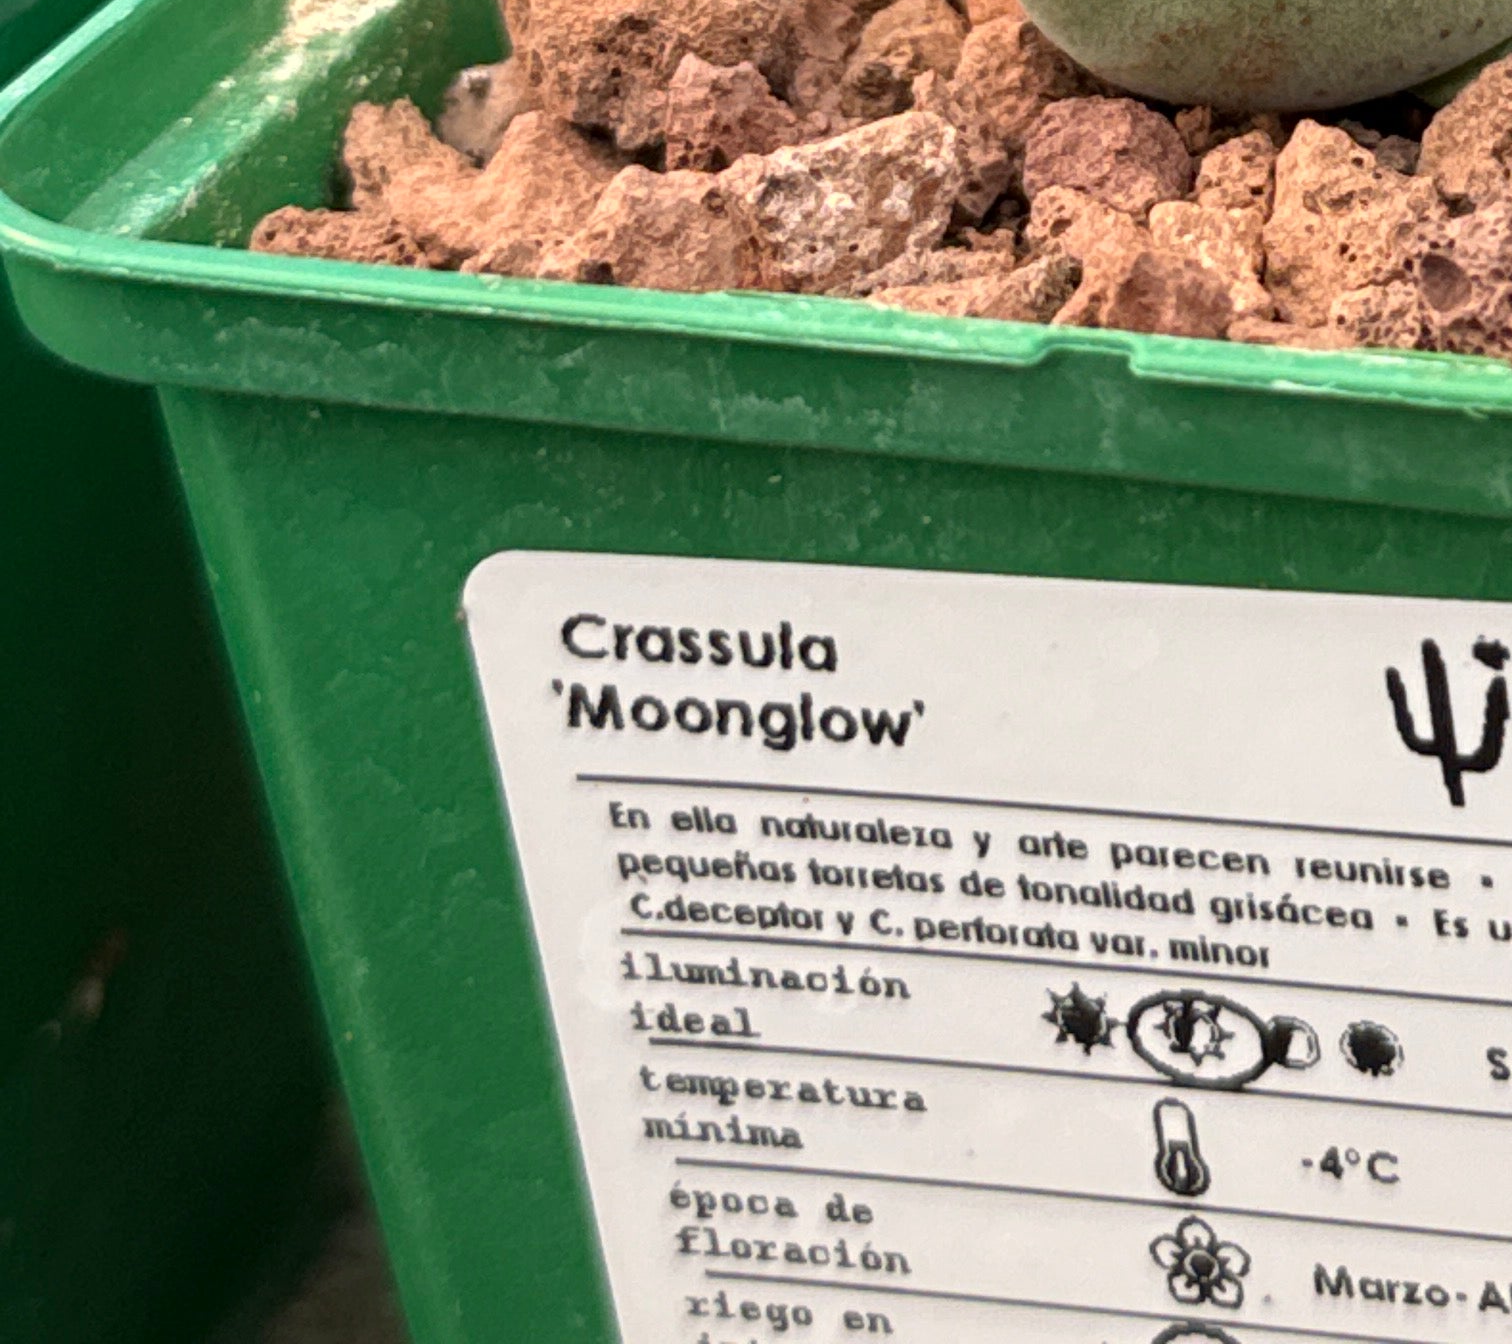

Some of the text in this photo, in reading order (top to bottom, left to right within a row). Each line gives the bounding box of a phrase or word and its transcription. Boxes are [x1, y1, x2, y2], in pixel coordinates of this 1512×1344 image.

[560, 613, 838, 674] Crassula
[552, 679, 925, 753] 'Moonglow'
[609, 801, 651, 830] En
[671, 806, 738, 836] ella
[760, 813, 953, 850] naturaleza
[973, 831, 991, 859] y
[1018, 831, 1088, 860] arte
[1110, 840, 1271, 876] parecen
[1295, 857, 1450, 890] reunirse
[617, 850, 797, 884] pequeñas
[807, 859, 945, 895] torretas
[959, 869, 1005, 899] de
[1017, 874, 1195, 916] tonalidad
[1209, 893, 1374, 931] grisácea
[1433, 909, 1469, 939] Es
[836, 911, 854, 936] y
[869, 909, 903, 939] C.
[1090, 933, 1158, 959] var.
[1169, 935, 1270, 968] minor
[621, 951, 911, 1000] iluminación
[630, 1001, 761, 1038] ideal
[639, 1065, 927, 1113] temperatura
[643, 1110, 804, 1150] mínima
[669, 1179, 873, 1226] época de
[675, 1226, 911, 1275] floración
[686, 1291, 893, 1335] riego en
